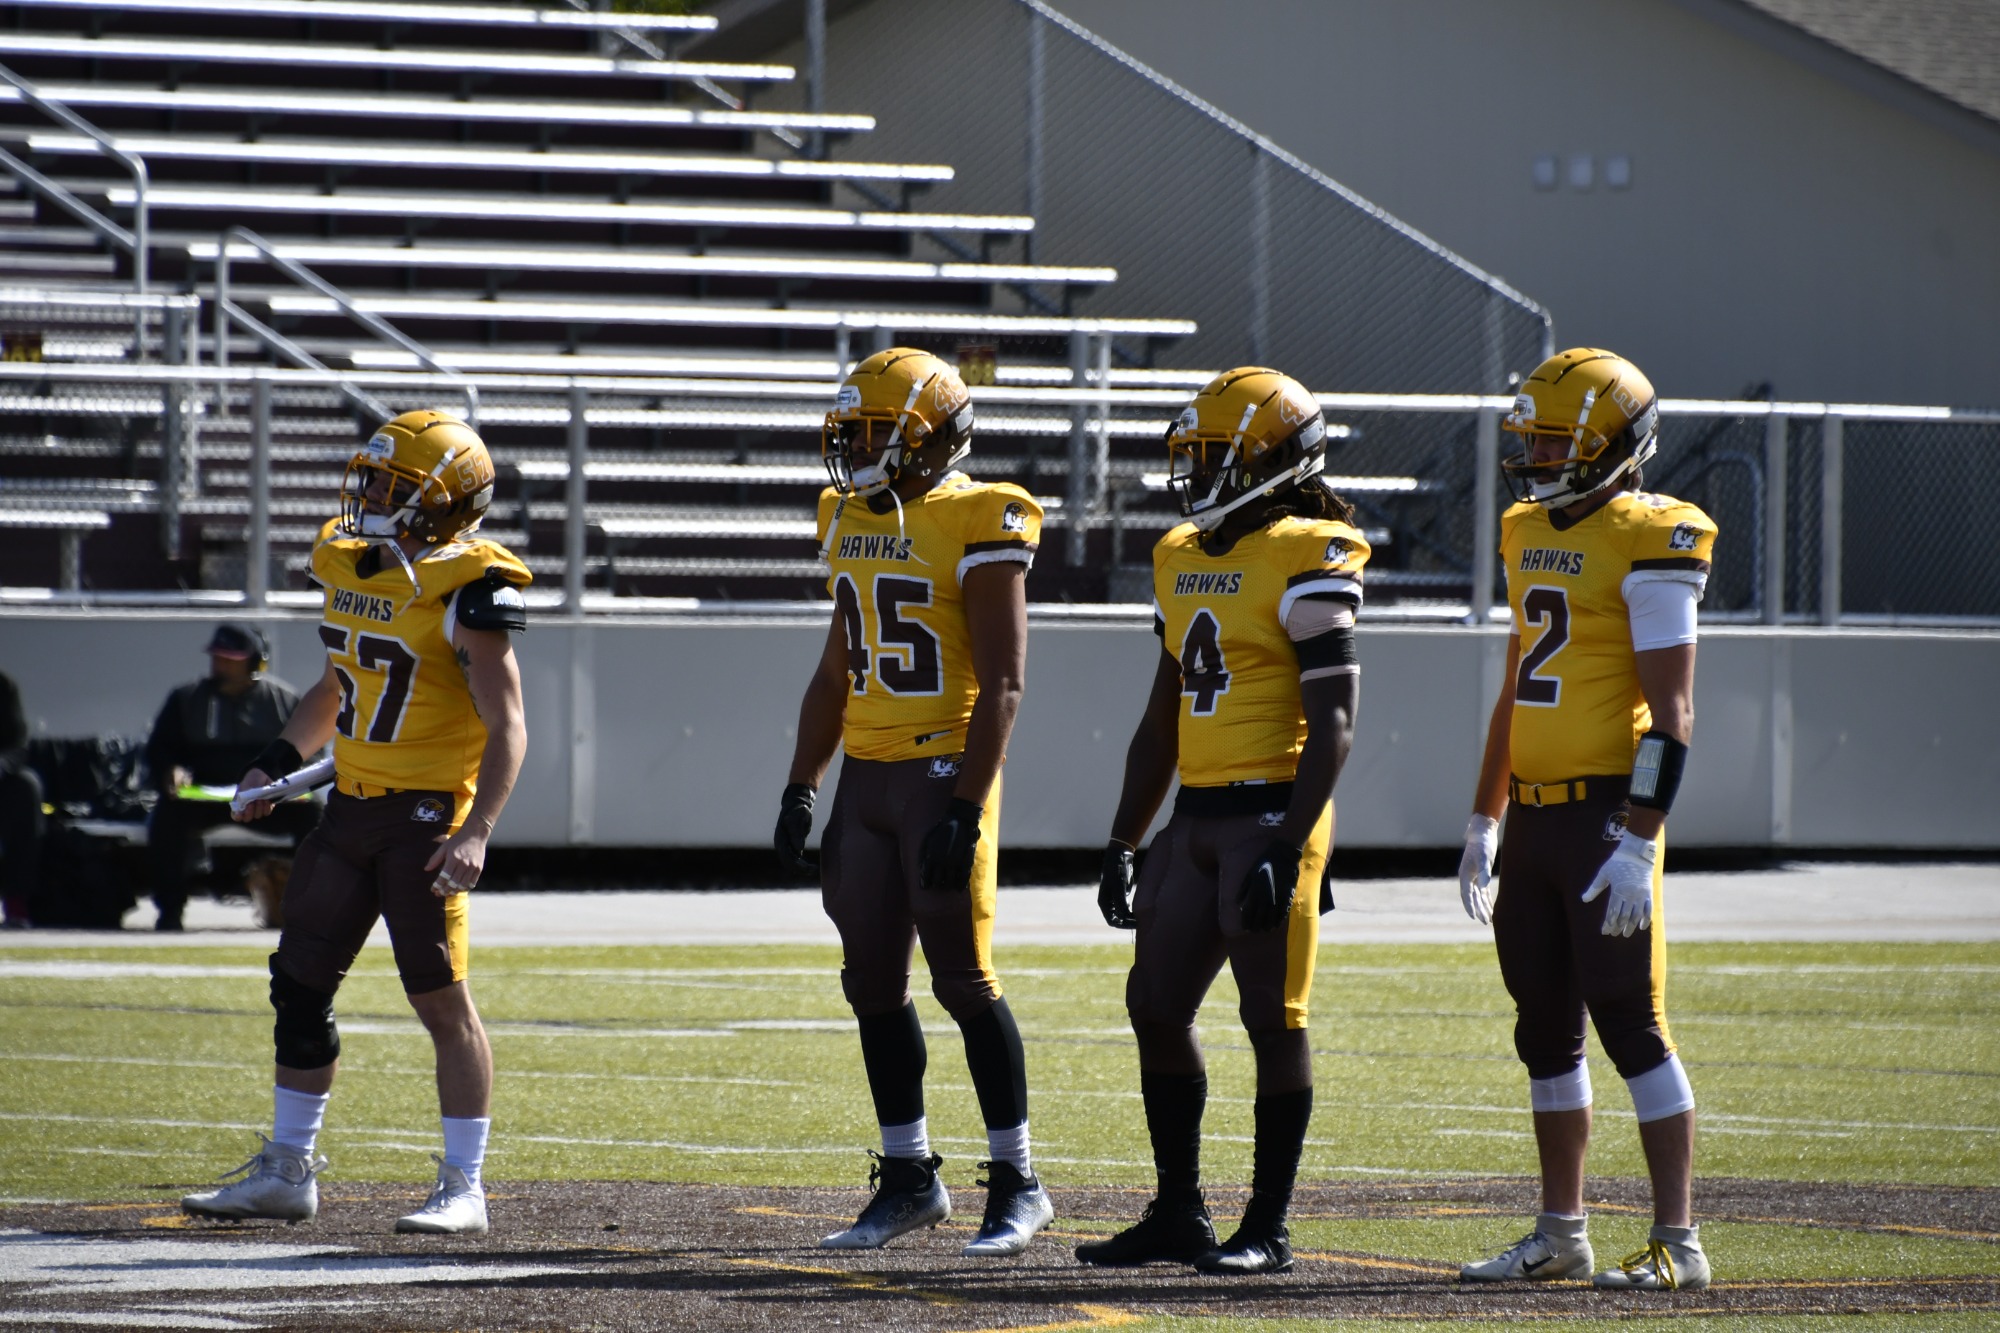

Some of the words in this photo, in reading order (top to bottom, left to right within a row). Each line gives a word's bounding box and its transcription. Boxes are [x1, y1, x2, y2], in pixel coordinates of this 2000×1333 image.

[934, 373, 969, 415] 45
[1280, 395, 1308, 426] 4
[1612, 383, 1642, 420] 2
[455, 451, 491, 493] 57
[837, 535, 914, 562] HAWKS
[1519, 547, 1585, 577] HAWKS
[1174, 570, 1244, 598] HAWKS
[331, 588, 394, 623] HAWKS
[833, 571, 944, 697] 45
[1515, 584, 1572, 708] 2
[1180, 606, 1233, 718] 4
[318, 621, 420, 744] 57
